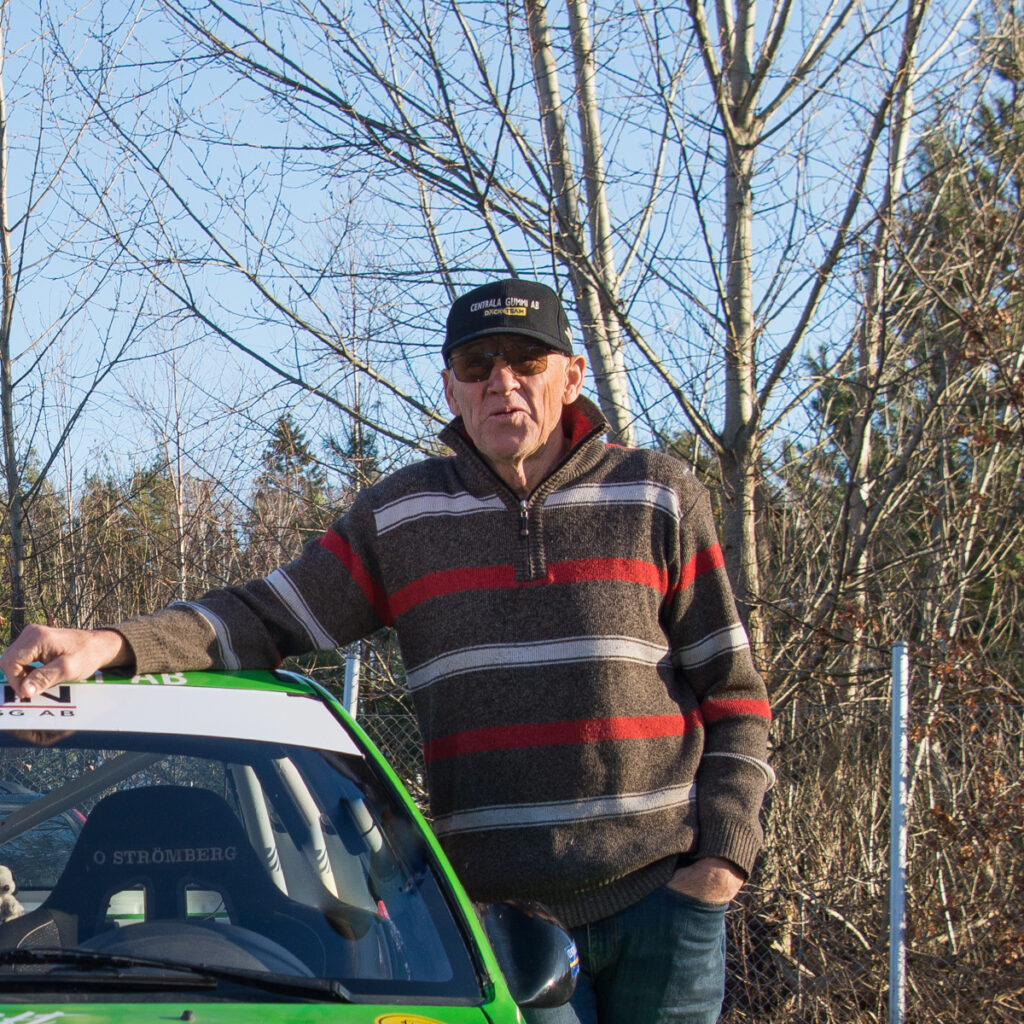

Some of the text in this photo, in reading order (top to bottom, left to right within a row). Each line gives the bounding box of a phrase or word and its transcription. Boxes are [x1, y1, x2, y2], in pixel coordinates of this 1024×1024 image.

[470, 297, 540, 313] CENTRALA GUMMI AB
[131, 672, 188, 686] AB
[39, 710, 75, 718] AB
[93, 847, 238, 865] O STRÖMBERG
